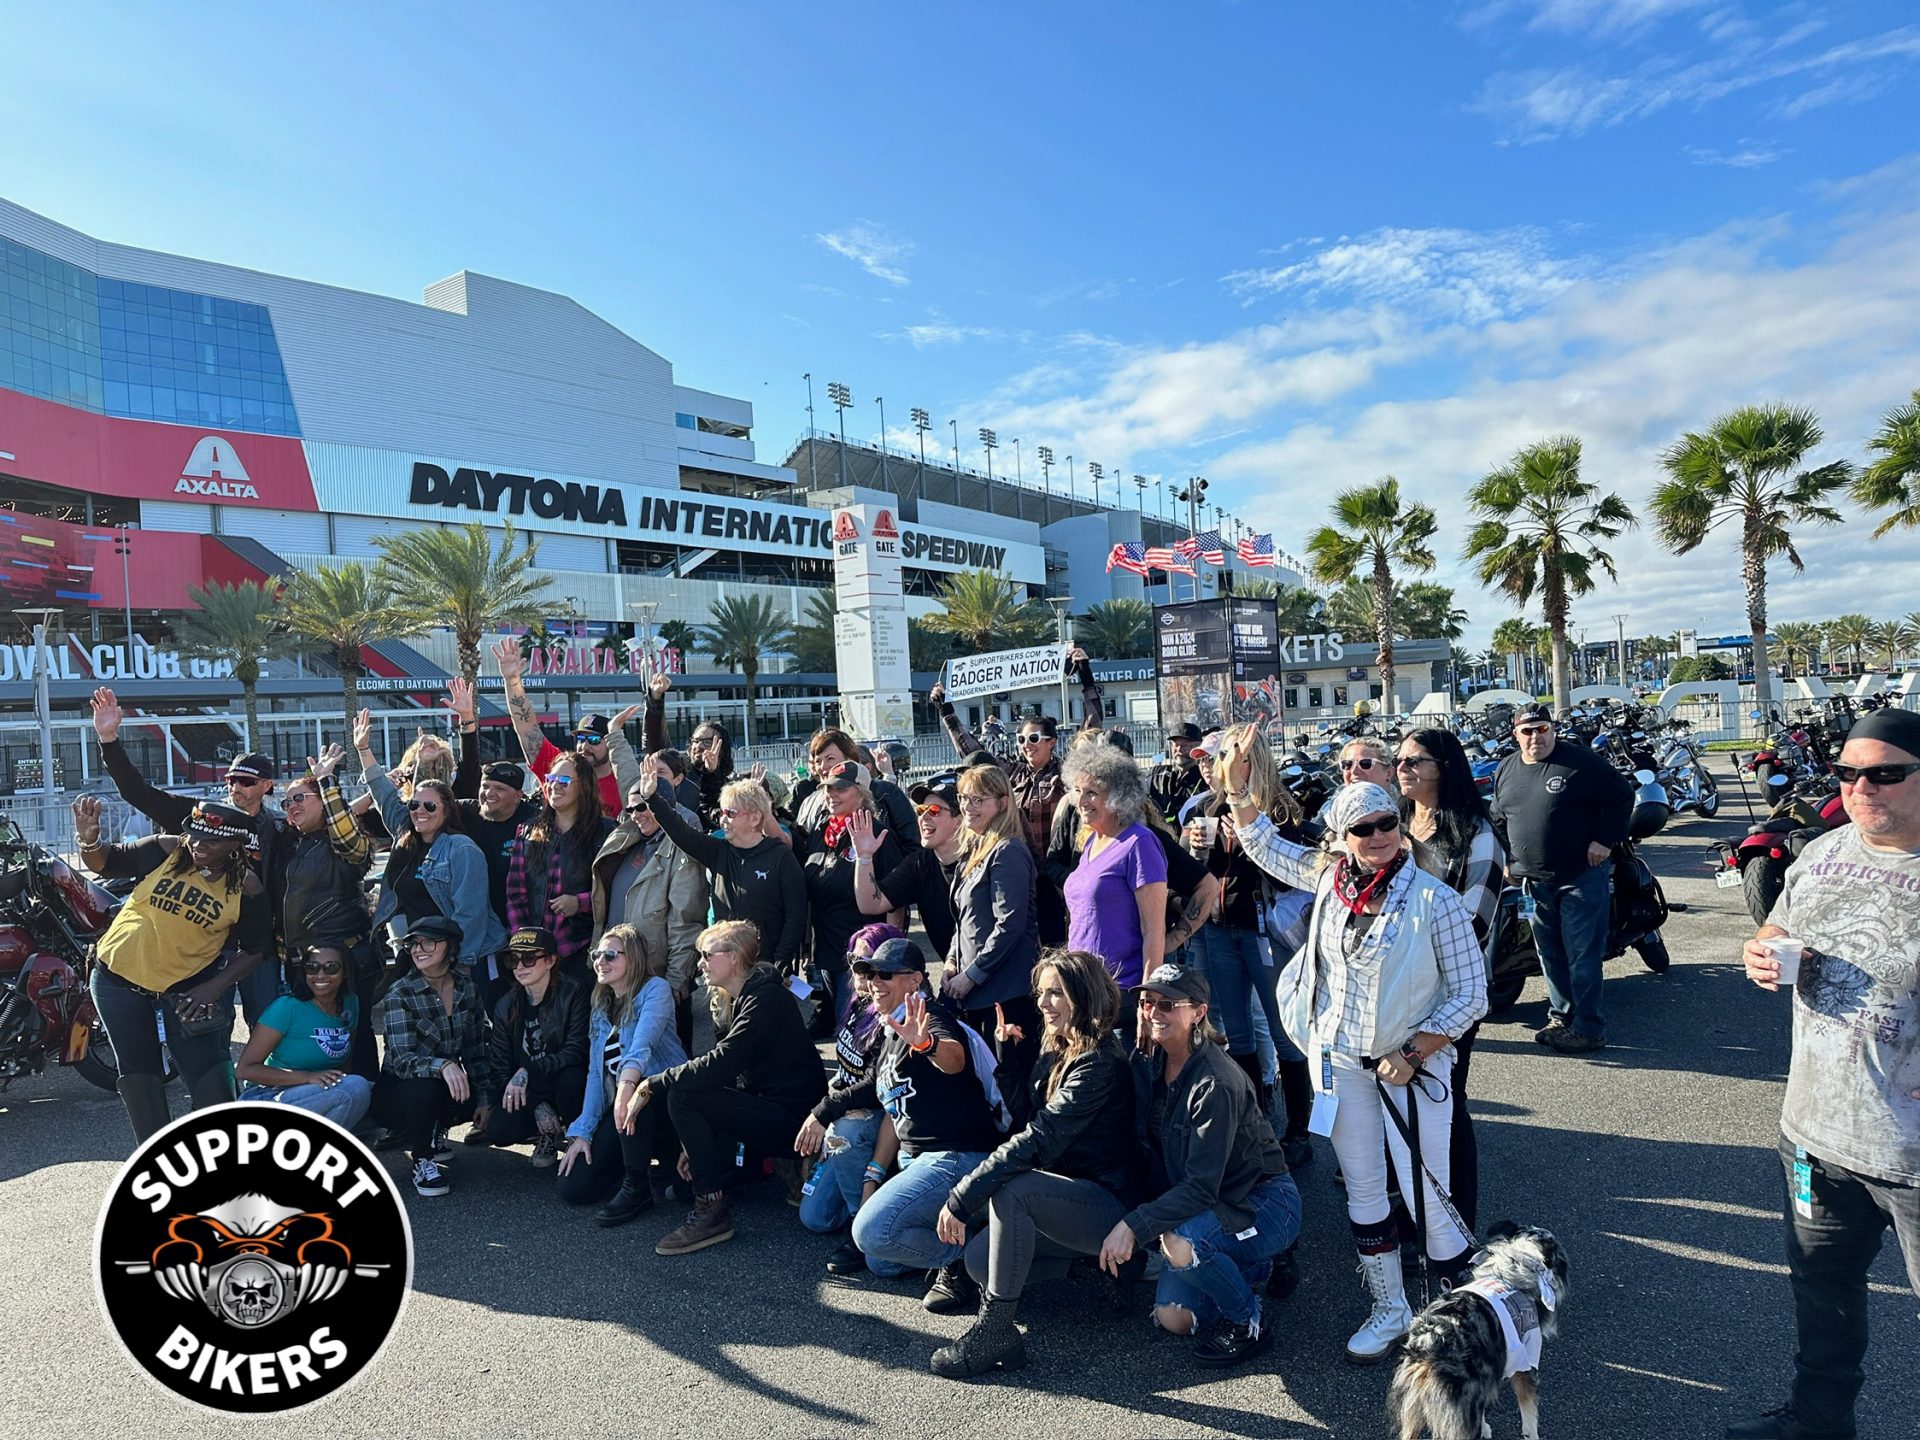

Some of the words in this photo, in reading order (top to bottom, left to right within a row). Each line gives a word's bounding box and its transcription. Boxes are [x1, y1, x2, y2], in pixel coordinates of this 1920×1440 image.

[174, 478, 260, 499] AXALTA
[409, 461, 628, 527] DAYTONA
[639, 496, 834, 549] INTERNATIO
[901, 530, 1007, 570] SPEEDWAY
[839, 541, 858, 556] GATE
[875, 540, 895, 553] GATE
[1161, 634, 1175, 646] WIN
[1175, 633, 1180, 645] A
[1180, 632, 1196, 644] 2024
[1279, 632, 1344, 664] KETS
[92, 644, 182, 680] CLUB
[529, 647, 619, 675] AXALTA
[1162, 645, 1178, 658] ROAD
[1179, 644, 1197, 657] GLIDE
[356, 679, 391, 690] ELCOME
[393, 679, 404, 690] TO
[406, 678, 443, 689] DAYTONA
[950, 666, 1003, 688] BADGER
[1009, 657, 1060, 678] NATION
[1093, 669, 1133, 682] ENTER
[951, 683, 1000, 698] #BADGERNATION
[1009, 673, 1059, 688] #SUPPORTBIKERS
[151, 878, 224, 921] BABES
[149, 895, 183, 916] RIDE
[184, 909, 214, 929] OUT
[1859, 1008, 1905, 1029] FAST
